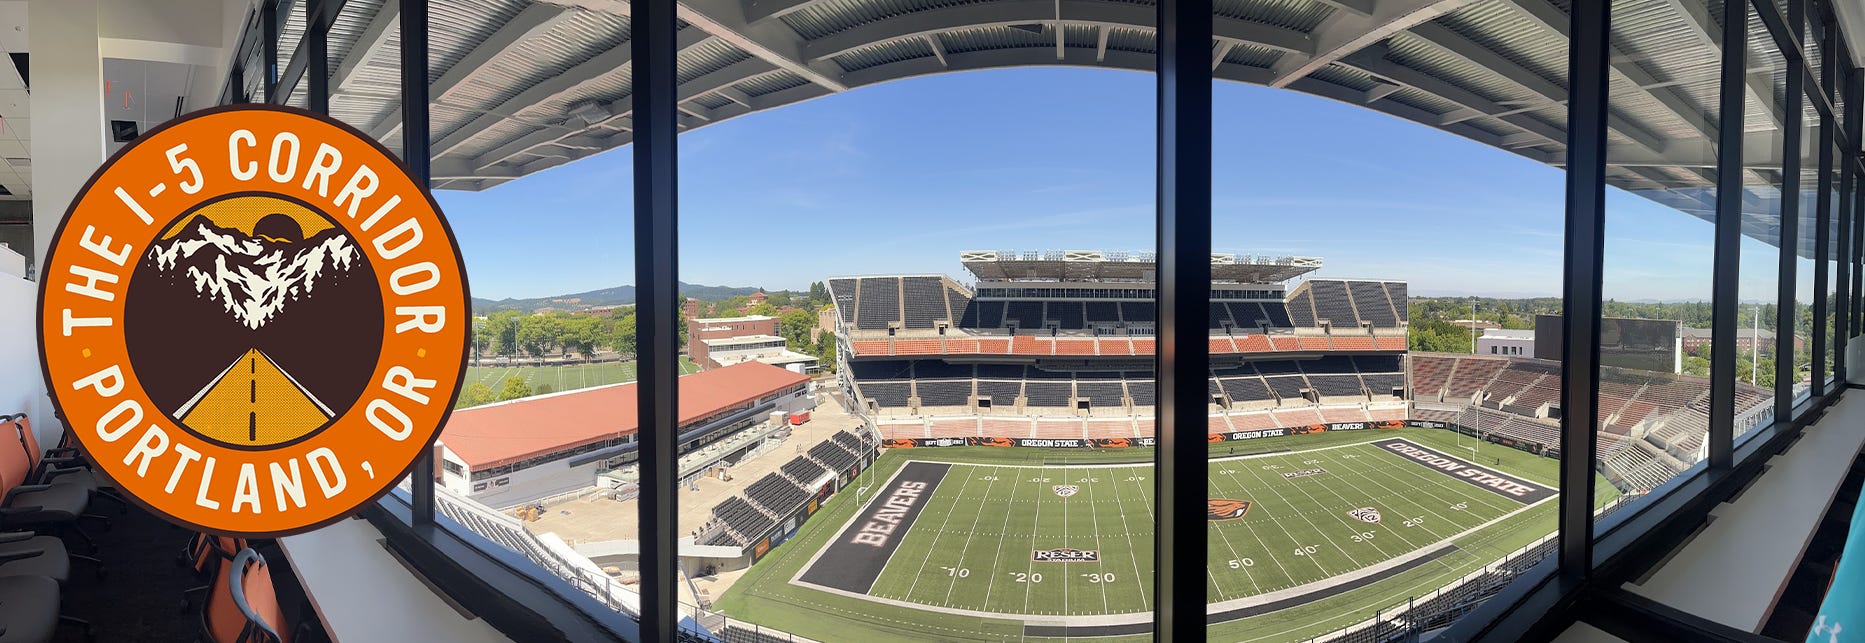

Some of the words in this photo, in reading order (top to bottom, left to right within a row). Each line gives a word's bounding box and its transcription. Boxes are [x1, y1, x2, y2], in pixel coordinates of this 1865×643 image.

[1331, 423, 1364, 431] BEAVERS
[1232, 430, 1262, 440] OREGON
[1262, 429, 1284, 438] STATE
[1021, 439, 1053, 448] OREGON
[1054, 439, 1079, 448] STATE
[1386, 441, 1465, 474] OREGON
[1456, 465, 1536, 497] STATE
[851, 480, 927, 547] BEAVERS
[1403, 517, 1424, 528] 20
[1351, 531, 1374, 543] 30
[1036, 550, 1097, 560] RESER
[1294, 545, 1317, 556] 40
[1229, 557, 1254, 569] 50
[947, 567, 970, 578] 10
[1015, 572, 1043, 583] 20
[1089, 572, 1116, 583] 30
